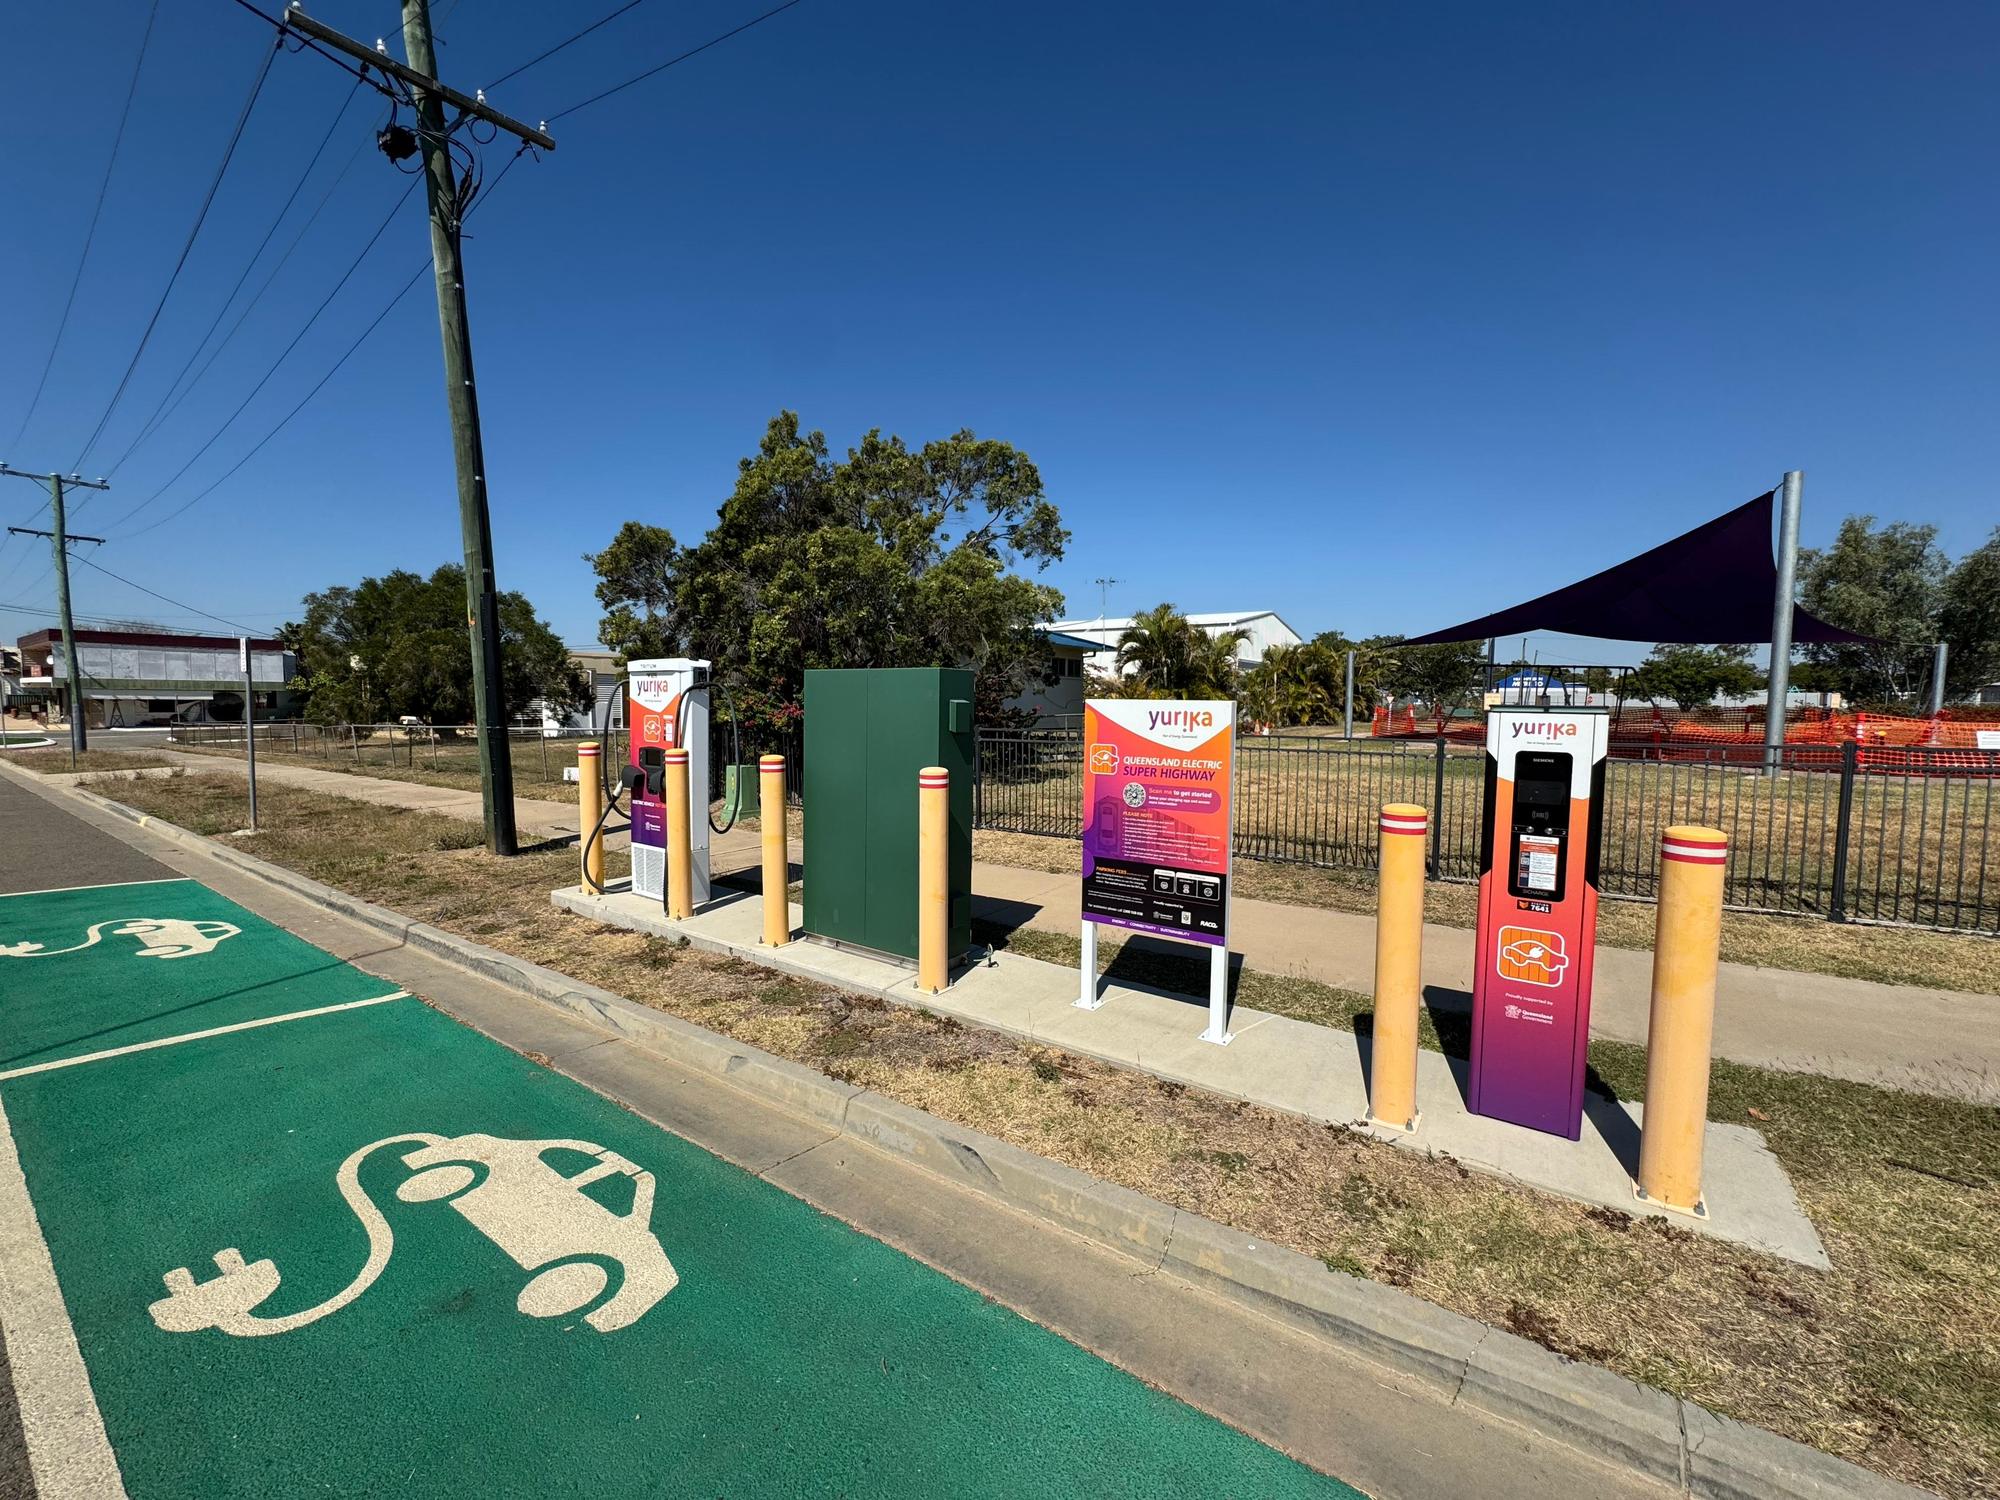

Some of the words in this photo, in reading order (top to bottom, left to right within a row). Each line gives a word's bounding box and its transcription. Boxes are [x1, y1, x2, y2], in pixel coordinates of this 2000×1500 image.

[637, 680, 669, 697] yurika
[1149, 710, 1213, 733] yurika
[1512, 721, 1577, 740] yurika
[1123, 756, 1180, 767] QUEENSLAND
[1183, 759, 1223, 769] ELECTRIC
[1123, 766, 1157, 777] SUPER
[1160, 768, 1215, 781] HIGHWAY
[1530, 904, 1550, 913] 7641
[1522, 1009, 1554, 1020] Queensland
